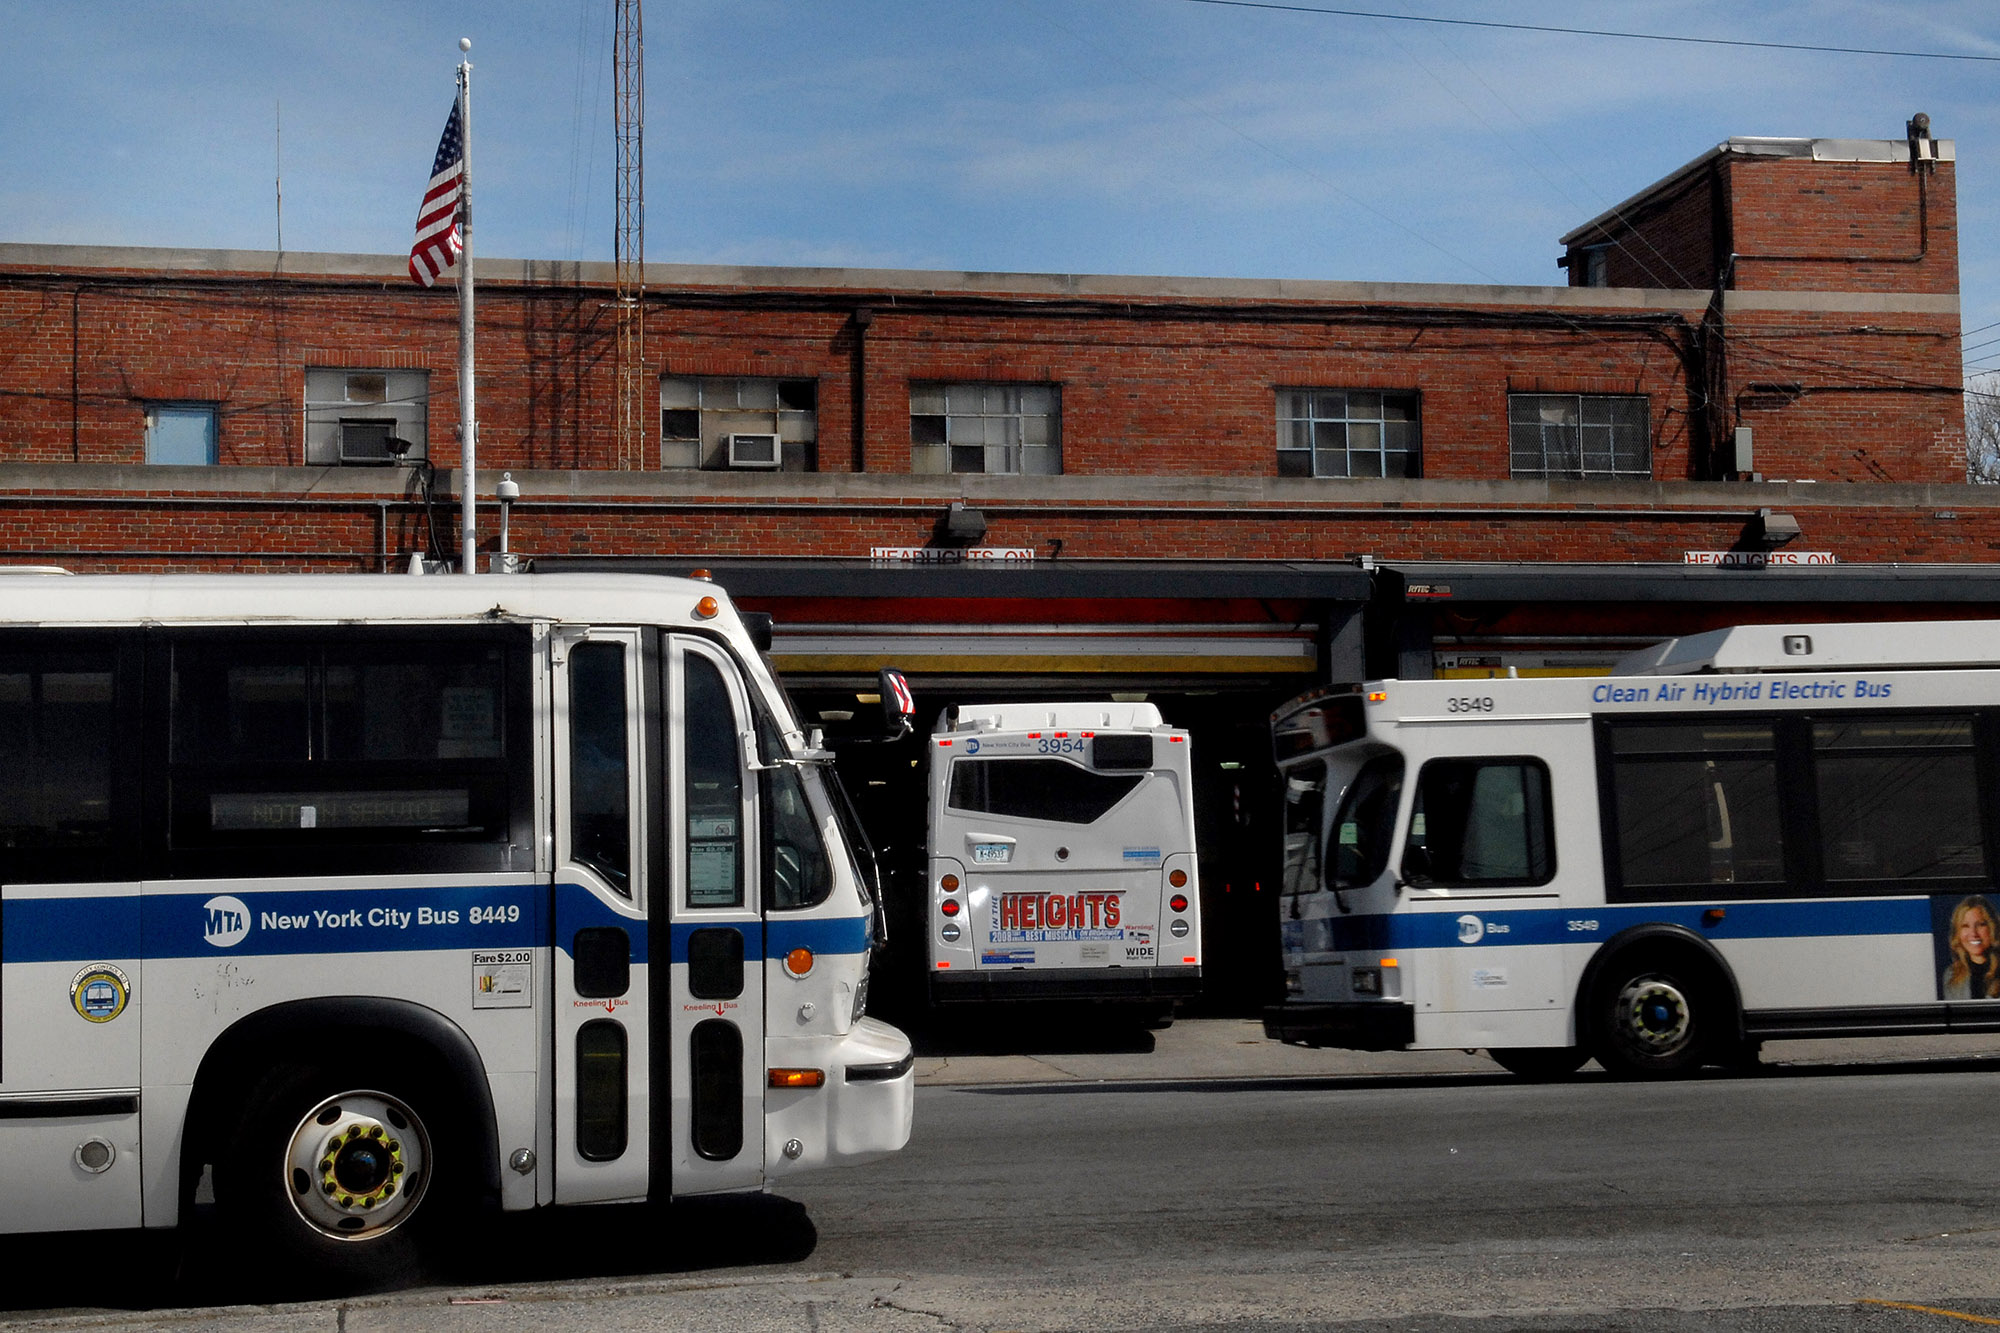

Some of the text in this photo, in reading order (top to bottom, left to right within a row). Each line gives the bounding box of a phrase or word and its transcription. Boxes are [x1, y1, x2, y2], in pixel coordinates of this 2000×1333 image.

[873, 549, 1032, 561] HEADLIGHTS ON
[1687, 553, 1834, 565] HEADLIGHTS ON
[1592, 680, 1892, 705] Clean Air Hybrid Electric Bus
[1447, 696, 1494, 712] 3549
[1038, 738, 1085, 753] 3954
[469, 905, 520, 924] 8449
[1000, 894, 1120, 931] HEIGHTS
[203, 905, 460, 939] MTA New York City Bus
[992, 917, 999, 929] IN
[1486, 922, 1510, 934] Bus
[1567, 920, 1599, 931] 3549
[992, 931, 1012, 943] 2008
[1025, 930, 1042, 941] BEST
[1045, 929, 1077, 941] MUSICAL
[1125, 947, 1154, 956] WIDE
[474, 953, 530, 965] Fare $2.00
[573, 998, 629, 1008] Kneeling Bus
[683, 1001, 738, 1011] Kneeling Bus
